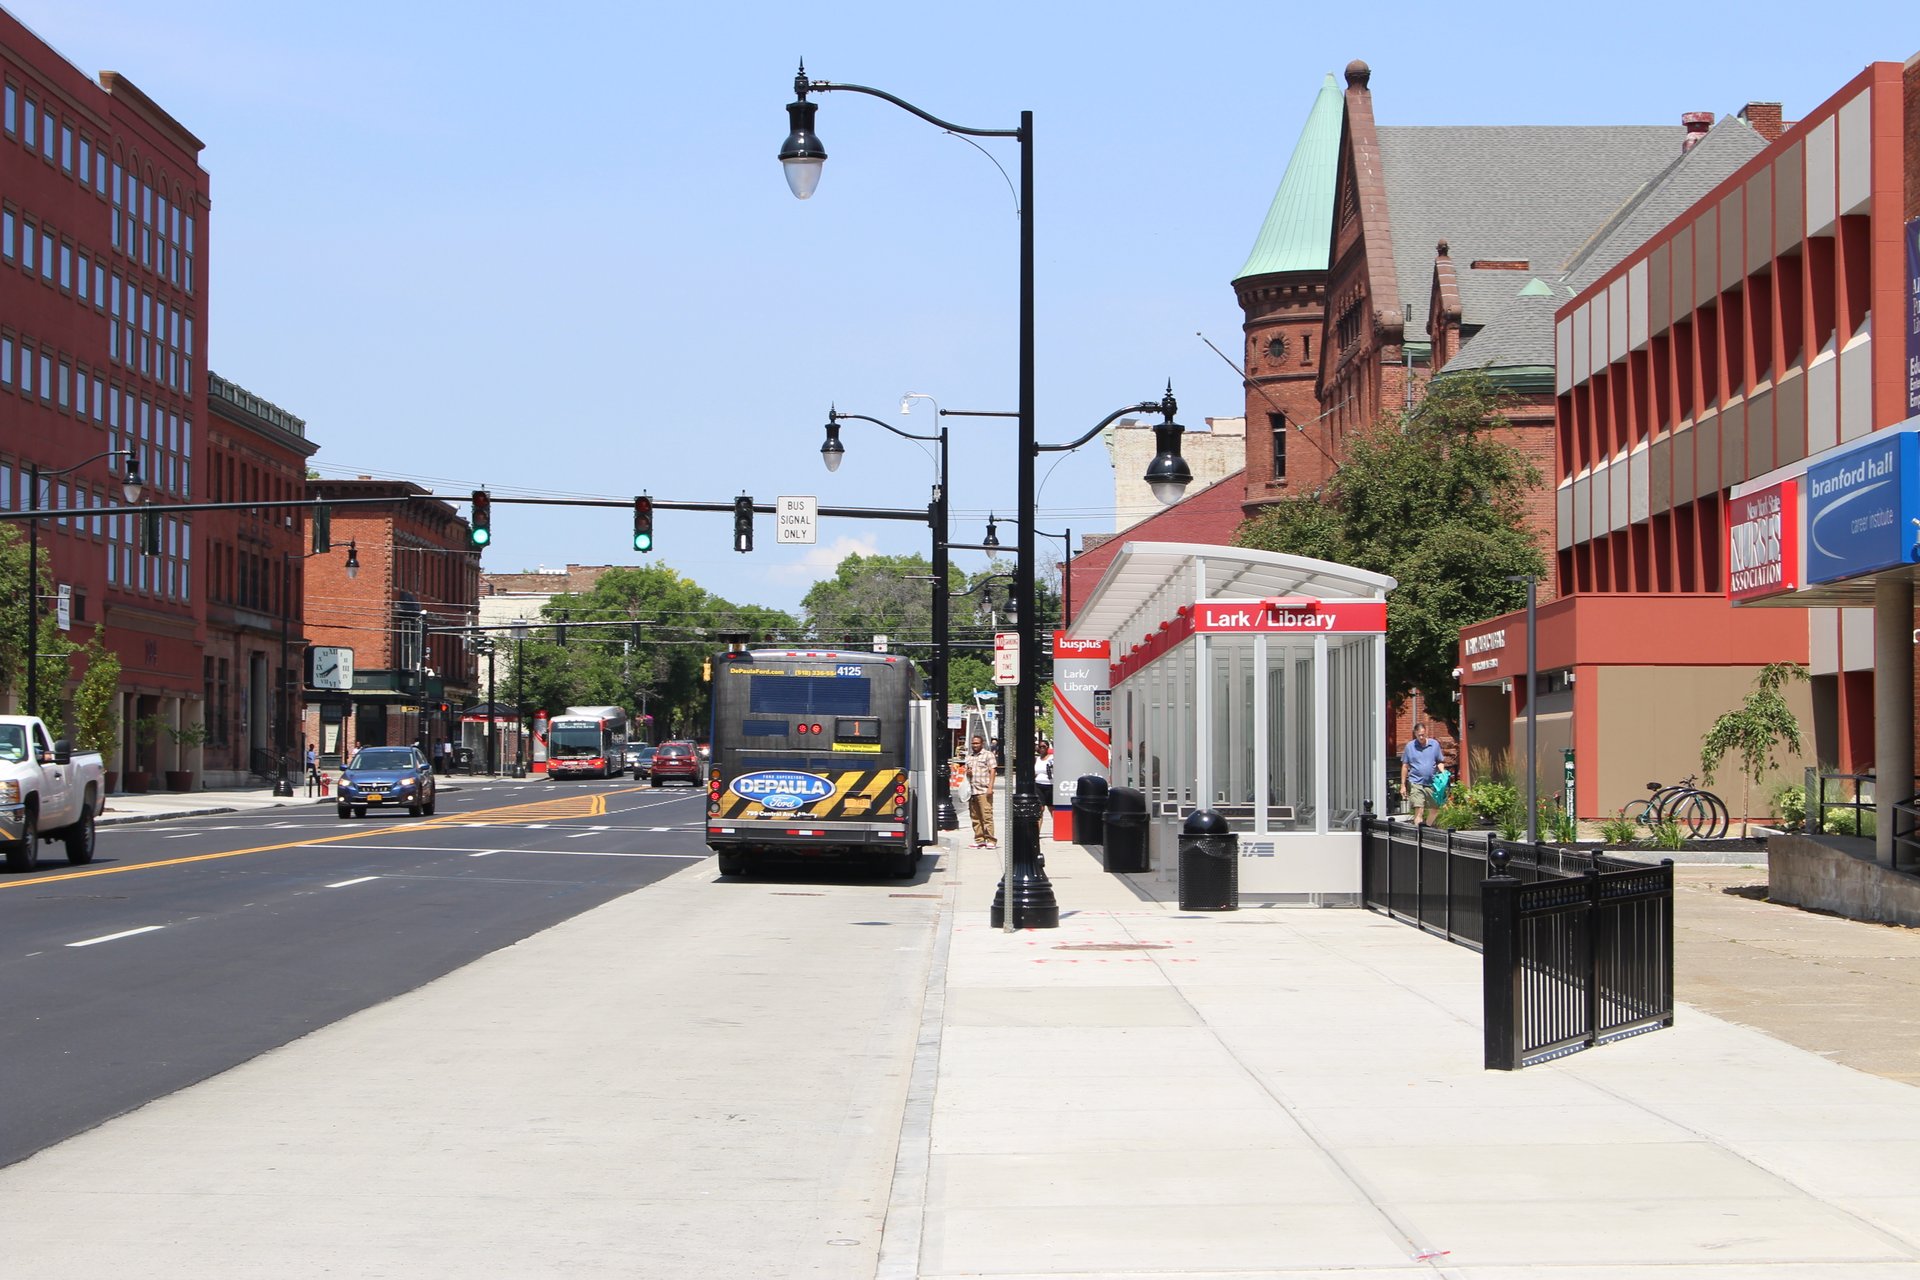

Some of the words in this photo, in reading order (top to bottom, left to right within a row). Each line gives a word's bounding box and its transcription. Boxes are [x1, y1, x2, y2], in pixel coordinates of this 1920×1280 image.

[1811, 461, 1865, 499] branford
[1867, 451, 1893, 480] hall
[787, 501, 805, 510] BUS
[1747, 501, 1758, 520] New
[1758, 495, 1768, 517] York
[1768, 494, 1781, 514] State
[780, 515, 811, 525] SIGNAL
[1851, 515, 1869, 534] career
[1869, 507, 1893, 529] institute
[784, 529, 807, 539] ONLY
[1730, 512, 1781, 573] NURSES
[1730, 562, 1782, 592] ASSOCIATION
[1206, 610, 1250, 627] Lark
[1255, 610, 1264, 627] /
[1267, 610, 1336, 630] Library
[1059, 638, 1102, 652] busplus
[837, 667, 862, 676] 4125
[1063, 669, 1090, 679] Lark/
[1063, 682, 1098, 693] Library
[740, 778, 826, 795] DEPAULA
[769, 796, 795, 808] Ford
